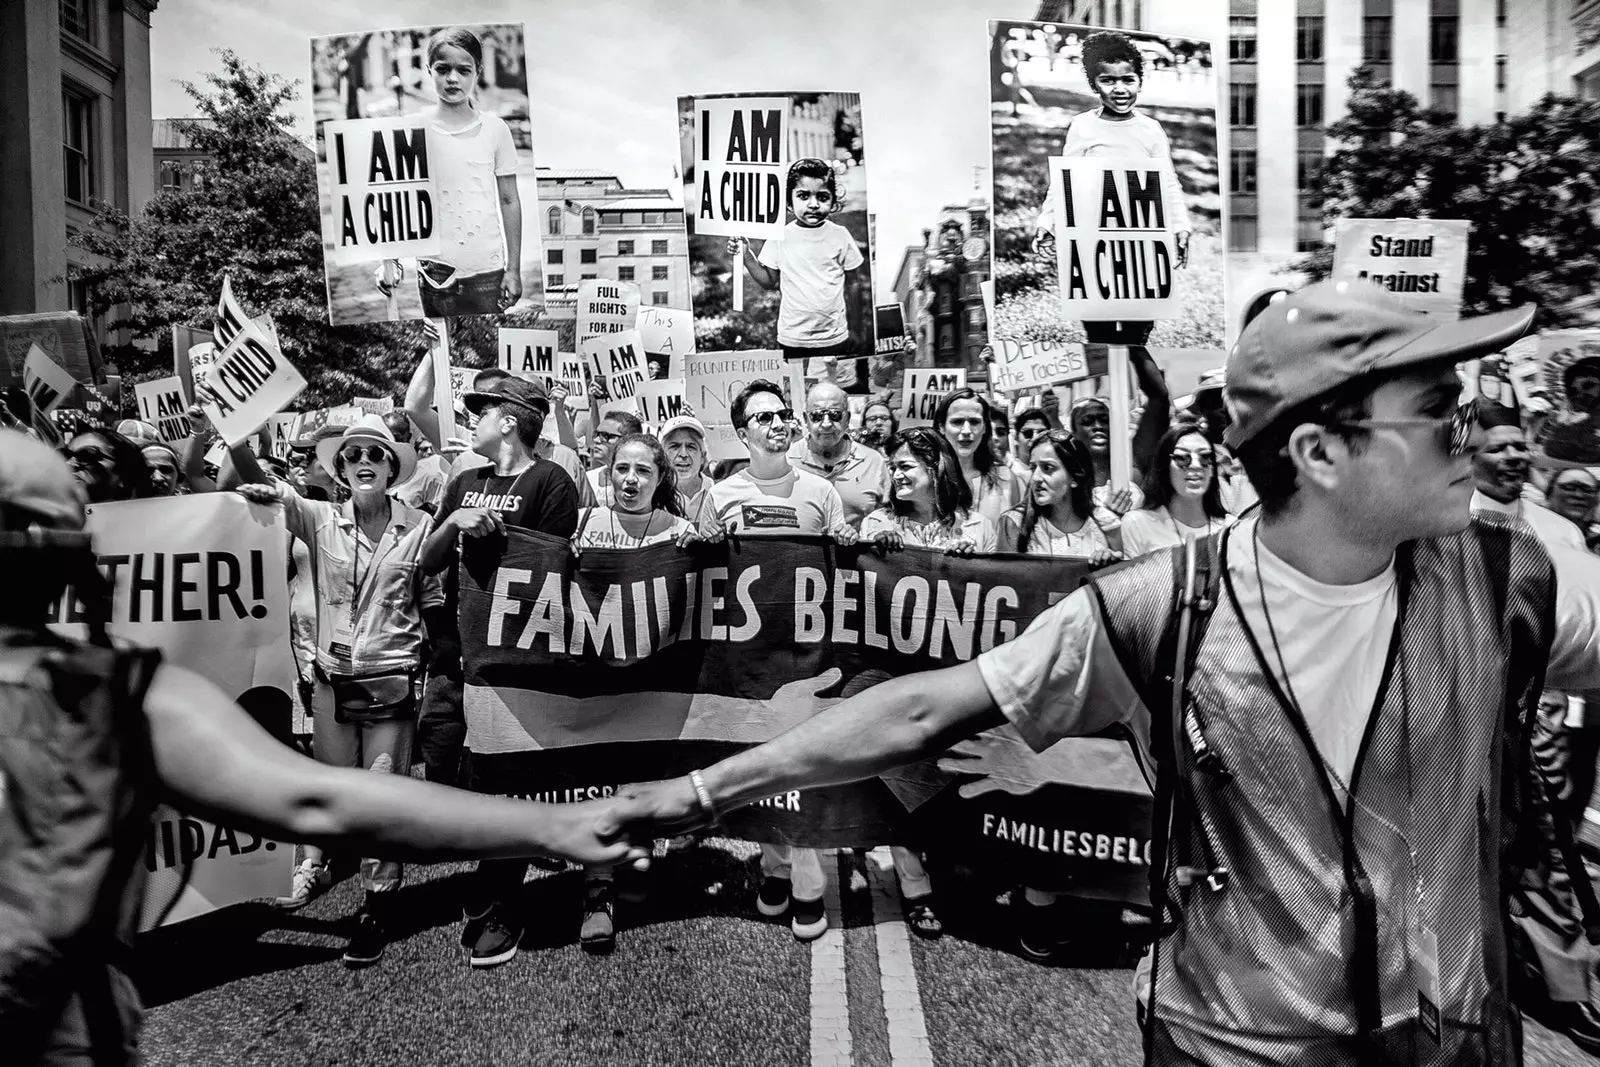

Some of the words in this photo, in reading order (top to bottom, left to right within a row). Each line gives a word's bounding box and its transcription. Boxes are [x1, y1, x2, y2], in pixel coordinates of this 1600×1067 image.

[702, 109, 709, 161] I
[726, 109, 782, 162] AM
[333, 132, 347, 185] I
[368, 127, 429, 182] AM
[700, 170, 713, 219] A
[720, 171, 780, 224] CHILD
[1060, 168, 1075, 228] I
[1100, 169, 1165, 228] AM
[341, 194, 358, 247] A
[363, 188, 433, 245] CHILD
[1369, 234, 1434, 257] Stand
[1068, 239, 1088, 300] A
[1095, 238, 1172, 300] CHILD
[1358, 270, 1440, 293] ainst
[597, 286, 619, 299] FULL
[589, 302, 627, 316] RIGHTS
[641, 308, 674, 329] This
[590, 322, 606, 333] FOR
[659, 336, 674, 351] A
[217, 337, 277, 403] CHILD
[506, 344, 512, 371] I
[522, 345, 553, 372] AM
[562, 361, 580, 378] AM
[592, 352, 602, 376] I
[608, 344, 638, 373] AM
[691, 360, 737, 377] REUNITE
[742, 358, 780, 374] FAMILIES
[998, 366, 1025, 389] the
[1031, 350, 1083, 381] racists
[911, 374, 917, 389] I
[926, 374, 958, 390] AM
[143, 397, 150, 419] I
[157, 391, 184, 417] AM
[205, 384, 236, 419] A
[642, 396, 649, 421] I
[658, 394, 682, 421] AM
[906, 392, 916, 419] A
[159, 416, 191, 443] CHILD
[461, 491, 523, 512] FAMILIES
[60, 550, 268, 625] THER!
[487, 564, 761, 661] FAMILIES
[794, 566, 1019, 661] BELONG
